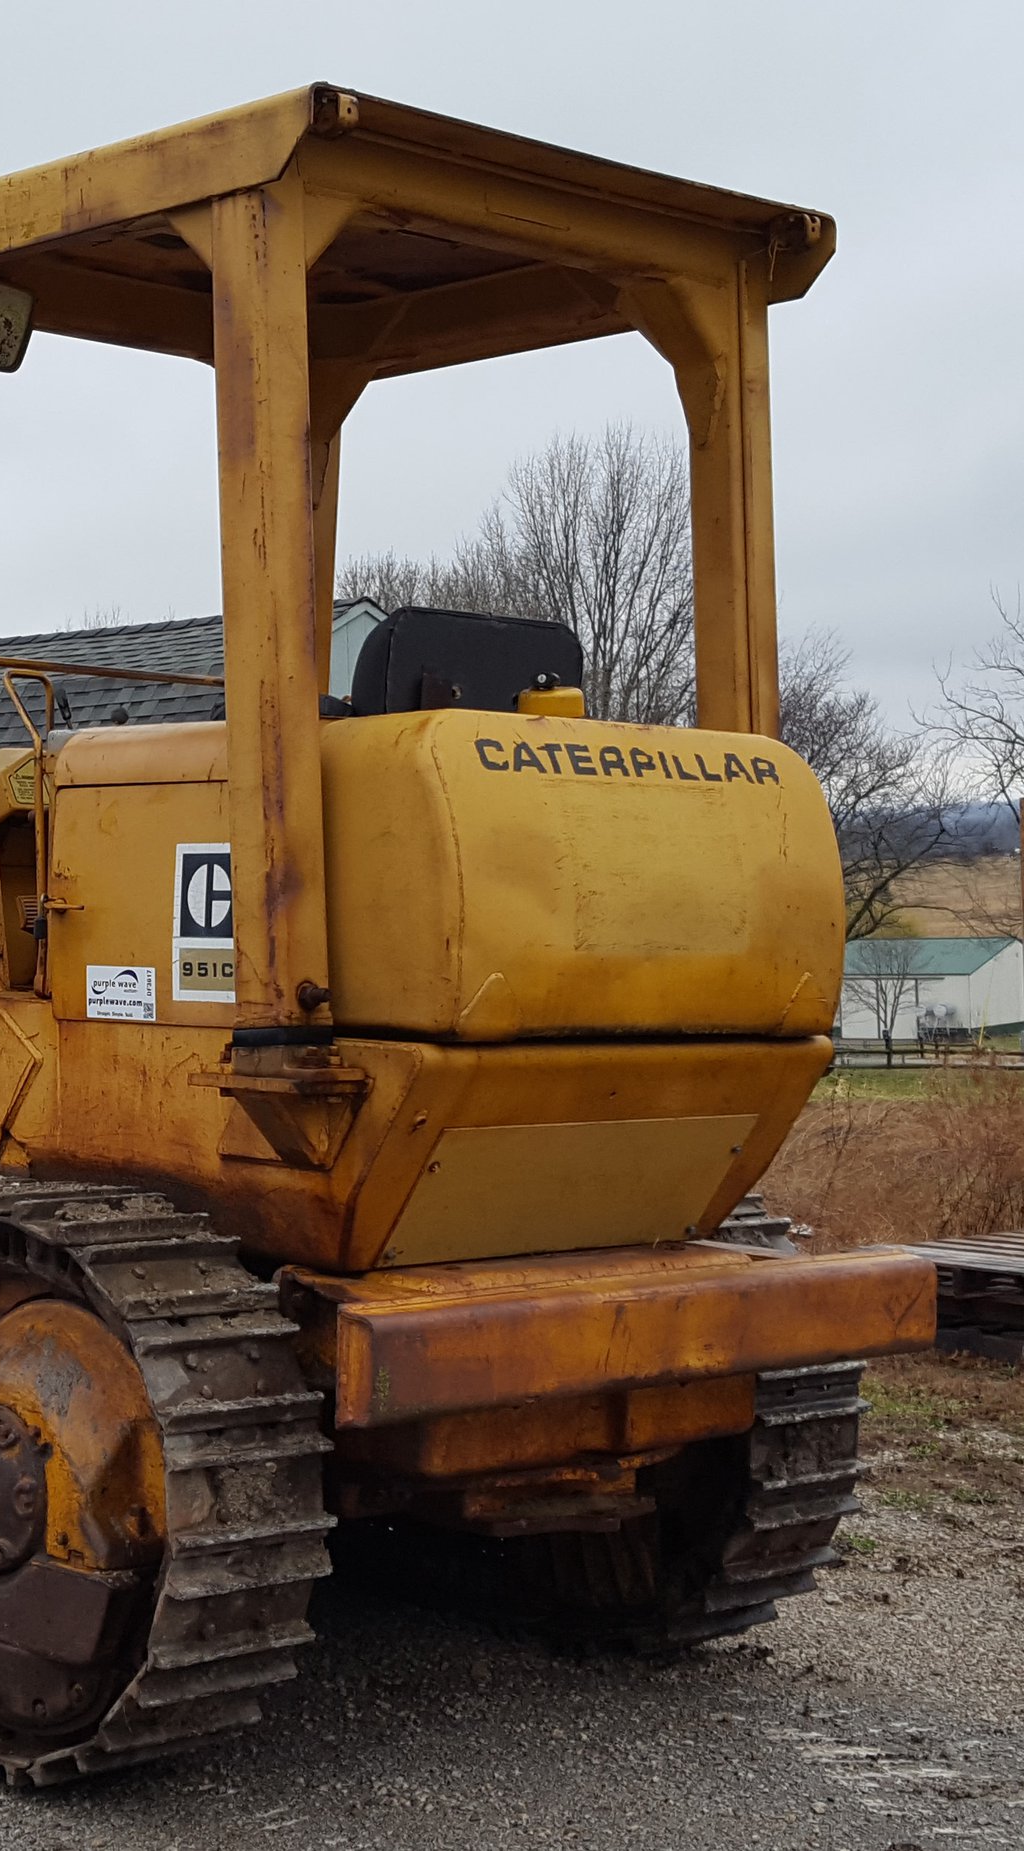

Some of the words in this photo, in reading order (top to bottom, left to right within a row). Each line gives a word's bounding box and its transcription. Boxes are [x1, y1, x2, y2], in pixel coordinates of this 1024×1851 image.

[474, 738, 780, 785] CATERPILLAR
[182, 962, 234, 978] 951C
[93, 979, 116, 989] purple
[118, 981, 137, 989] wave
[88, 996, 143, 1007] purplewave.com
